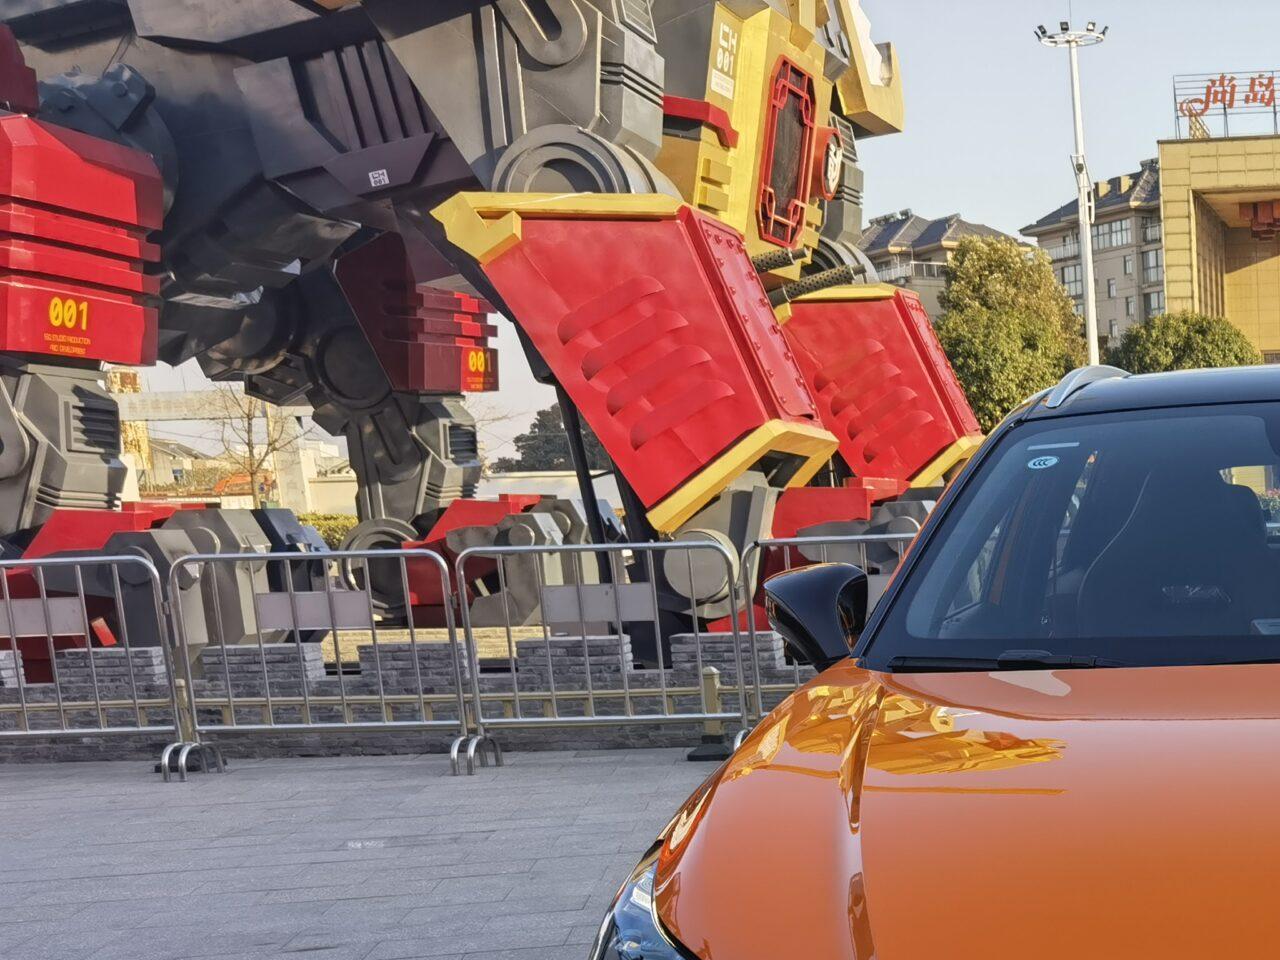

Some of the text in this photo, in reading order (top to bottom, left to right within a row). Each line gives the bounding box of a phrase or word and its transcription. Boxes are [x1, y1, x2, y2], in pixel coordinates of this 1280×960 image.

[720, 22, 738, 54] CH
[716, 47, 734, 76] 001
[49, 297, 88, 331] 001
[468, 351, 491, 372] 001
